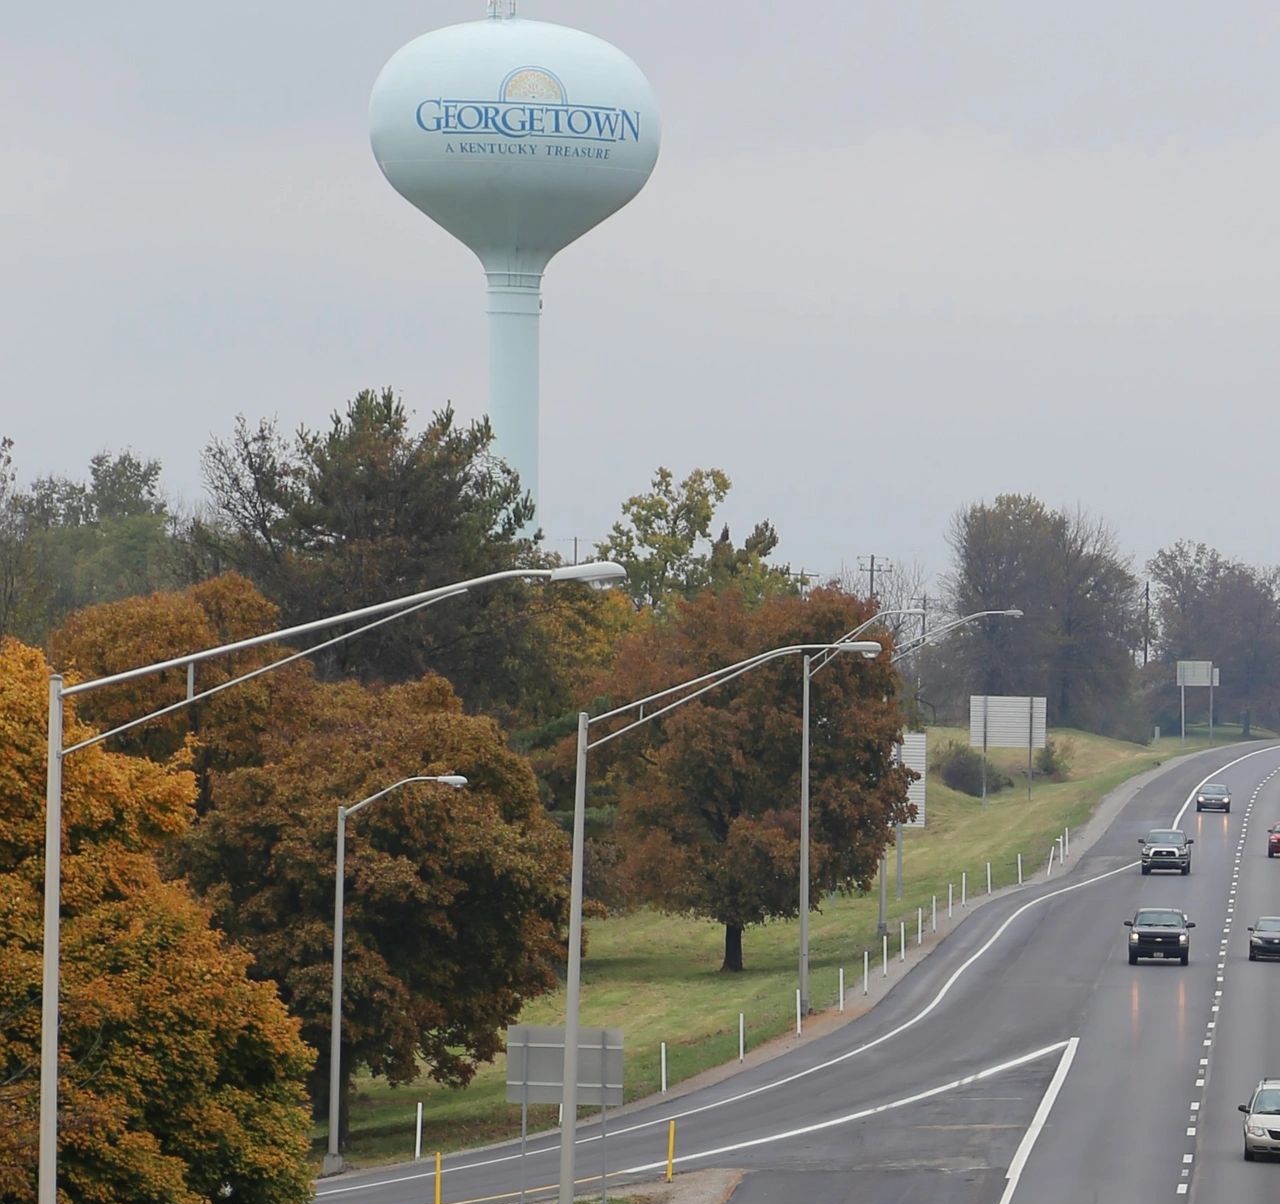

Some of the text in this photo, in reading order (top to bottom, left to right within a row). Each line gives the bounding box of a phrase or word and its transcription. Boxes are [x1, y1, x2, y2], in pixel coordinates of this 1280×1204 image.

[415, 97, 640, 143] GEORGETOWN
[445, 142, 611, 160] A KENTUCKY TREASURE
